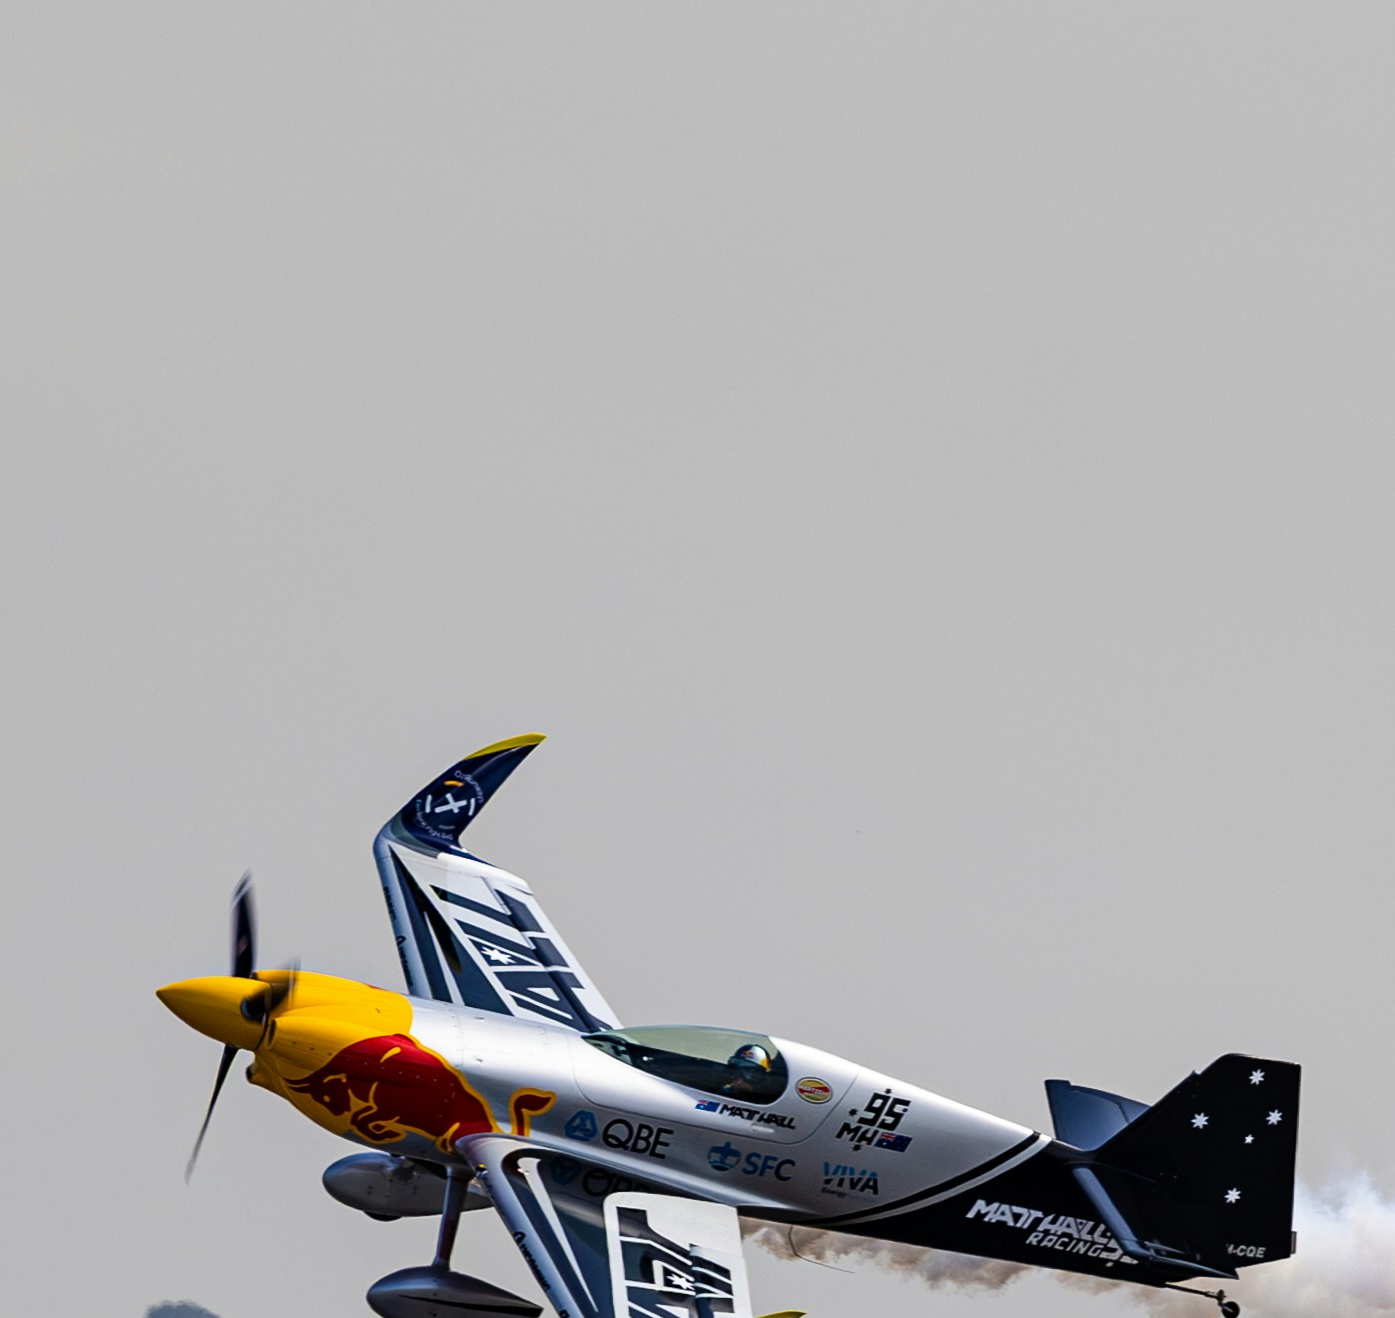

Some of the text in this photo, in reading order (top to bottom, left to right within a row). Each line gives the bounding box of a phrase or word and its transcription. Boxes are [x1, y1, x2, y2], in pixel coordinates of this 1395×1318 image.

[719, 1103, 760, 1122] MATT
[856, 1092, 911, 1132] 95
[602, 1118, 675, 1160] QBE
[835, 1122, 877, 1146] MH
[742, 1151, 796, 1182] SFC
[822, 1161, 880, 1196] VIVA
[965, 1199, 1112, 1245] MATT HALL
[1025, 1232, 1105, 1258] RACING
